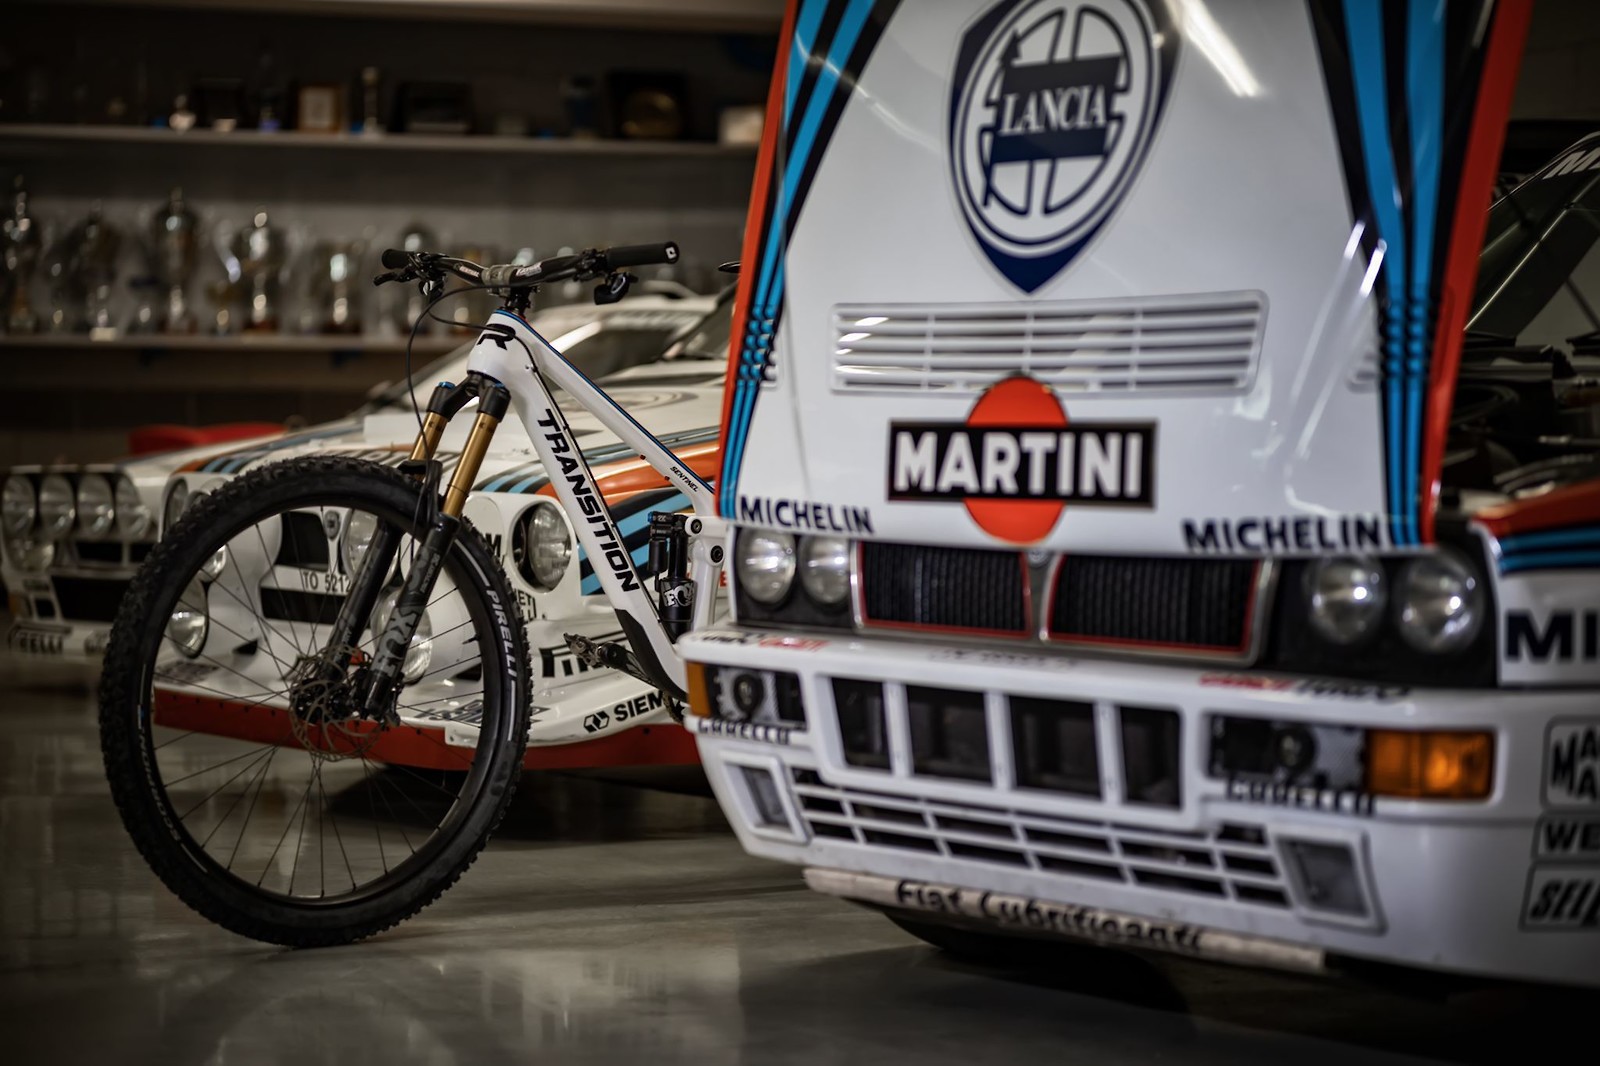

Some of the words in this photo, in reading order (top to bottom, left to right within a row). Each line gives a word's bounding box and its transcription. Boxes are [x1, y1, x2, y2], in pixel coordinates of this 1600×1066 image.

[1000, 84, 1107, 136] LANCIA
[670, 466, 699, 492] SENTINEL
[893, 430, 1144, 498] MARTINI
[537, 408, 640, 592] TRANSITION
[740, 495, 875, 535] MICHELIN
[1182, 515, 1381, 551] MICHELIN
[302, 570, 318, 590] TO
[370, 606, 419, 679] FOX
[486, 589, 518, 678] PIRELLI
[896, 879, 963, 912] Fiat
